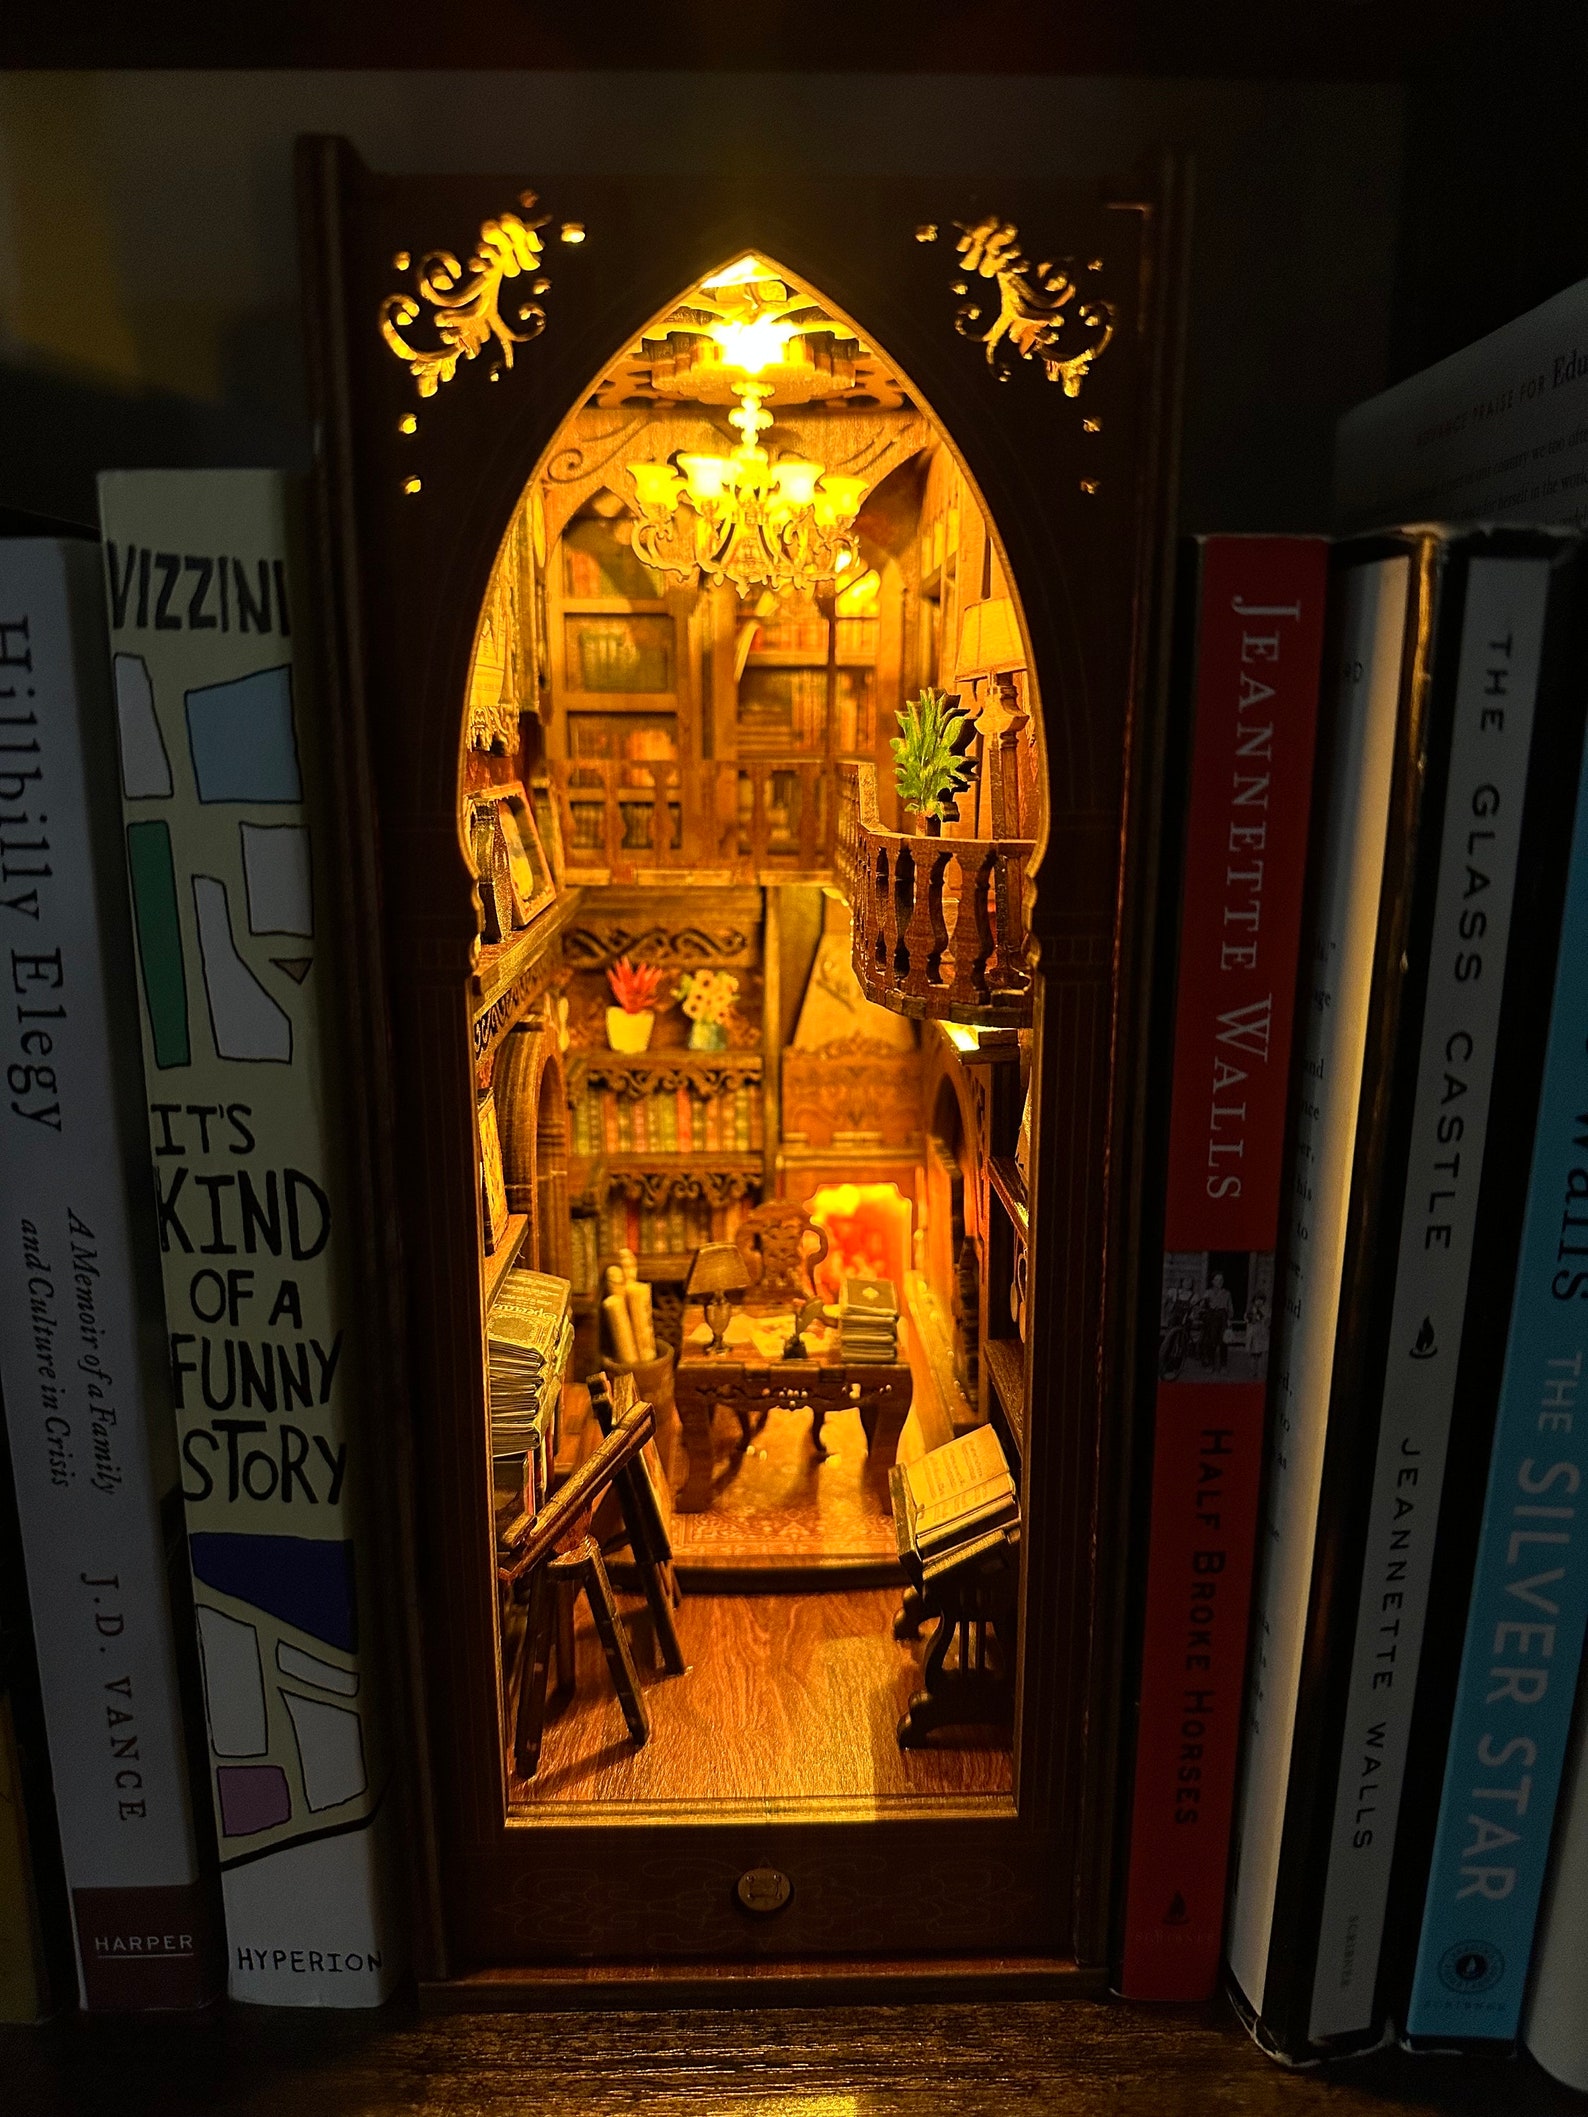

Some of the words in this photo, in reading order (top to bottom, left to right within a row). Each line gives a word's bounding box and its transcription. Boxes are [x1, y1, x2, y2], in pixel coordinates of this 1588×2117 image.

[105, 541, 292, 638] VIZZINI
[1481, 635, 1513, 733] THE
[1454, 783, 1500, 982] GLASS
[7, 947, 67, 1132] Elegy
[151, 1102, 256, 1156] IT'S
[1424, 1032, 1474, 1251] CASTLE
[21, 1217, 52, 1273] and
[66, 1206, 96, 1240] A
[156, 1167, 331, 1262] KIND
[28, 1276, 58, 1380] Culture
[71, 1242, 106, 1350] Memoir
[190, 1268, 254, 1327] OF
[268, 1280, 302, 1329] A
[41, 1381, 67, 1411] in
[78, 1354, 113, 1386] of
[88, 1382, 104, 1400] a
[171, 1330, 344, 1412] FUNNY
[1537, 1350, 1583, 1434] THE
[45, 1416, 77, 1488] Crisis
[89, 1403, 123, 1496] Family
[1193, 1427, 1235, 1533] HALF
[1373, 1438, 1420, 1692] JEANNETTE
[1490, 1457, 1581, 1706] SILVER
[80, 1571, 127, 1654] J.D.
[105, 1676, 149, 1823] VANCE
[1353, 1721, 1387, 1851] WALLS
[1455, 1734, 1538, 1902] STAR
[94, 1932, 194, 1954] HARPER
[237, 1945, 383, 1974] HYPERION
